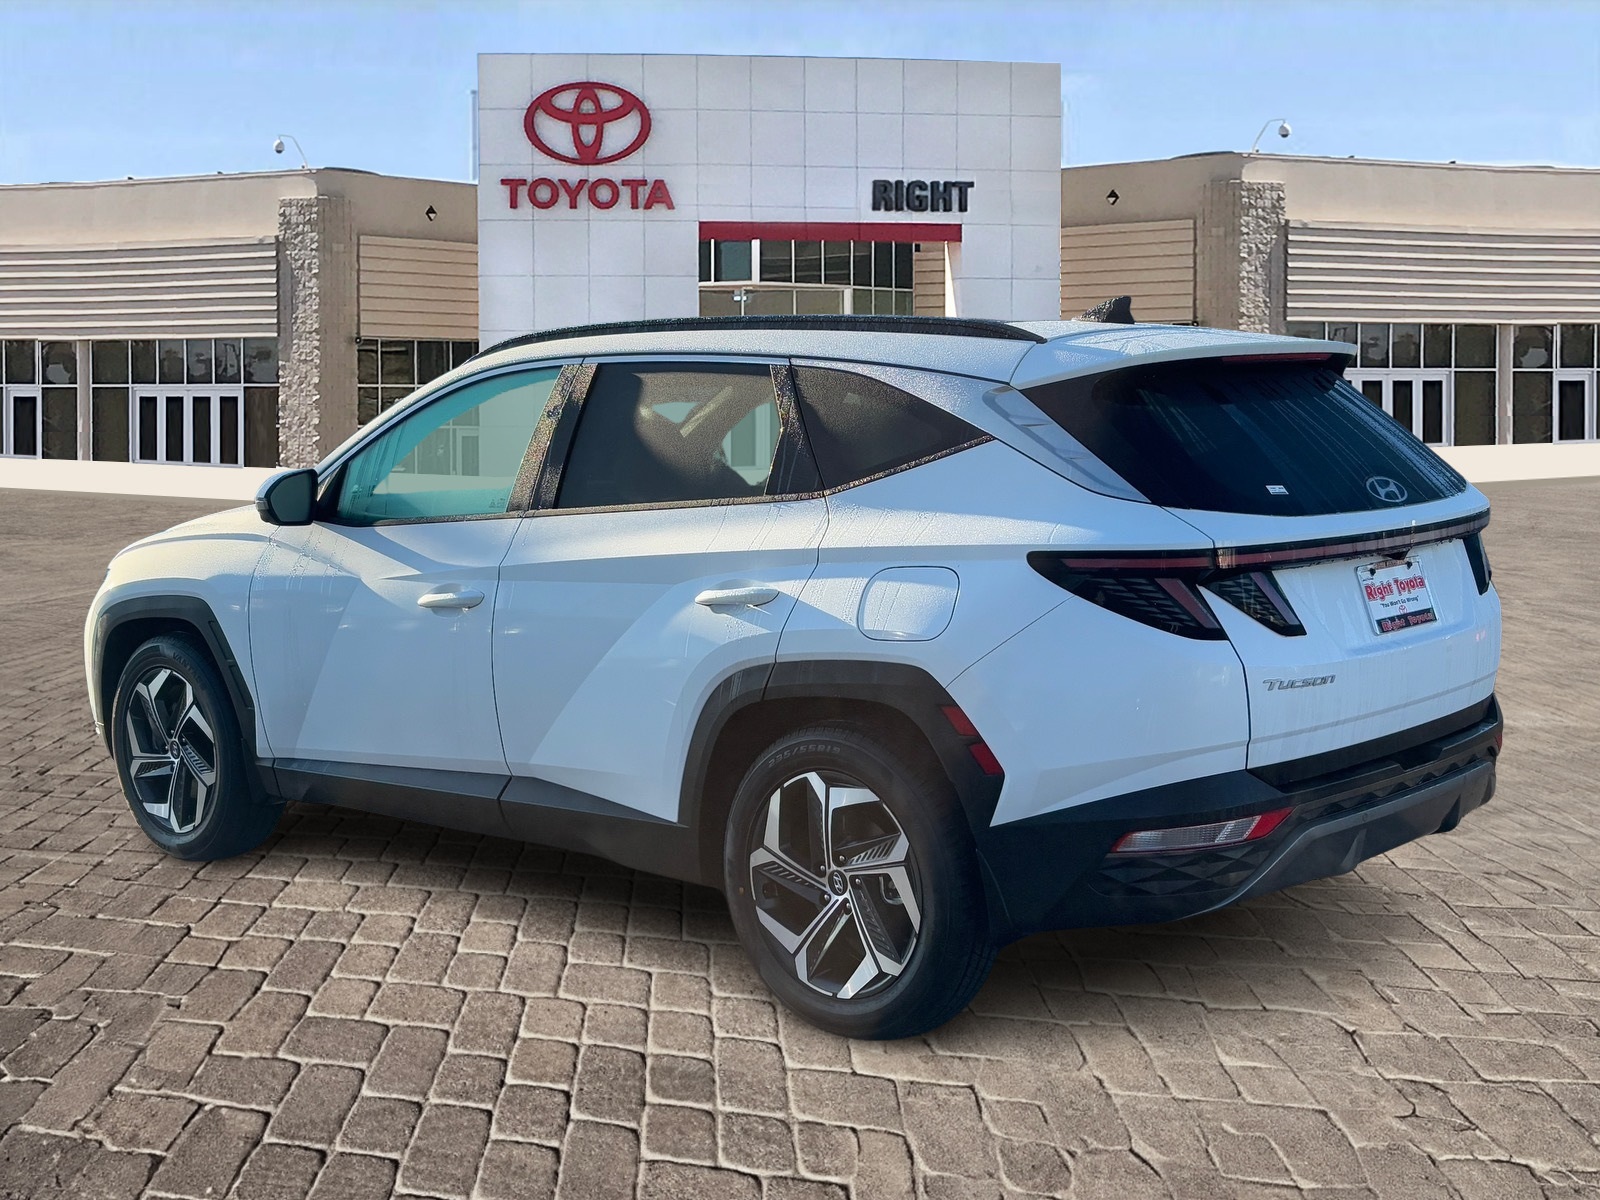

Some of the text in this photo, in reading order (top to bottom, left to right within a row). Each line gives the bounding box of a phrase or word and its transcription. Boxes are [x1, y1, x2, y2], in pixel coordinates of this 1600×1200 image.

[500, 178, 676, 210] TOYOTA
[871, 179, 975, 213] RIGHT
[1365, 574, 1426, 601] Right Toyota
